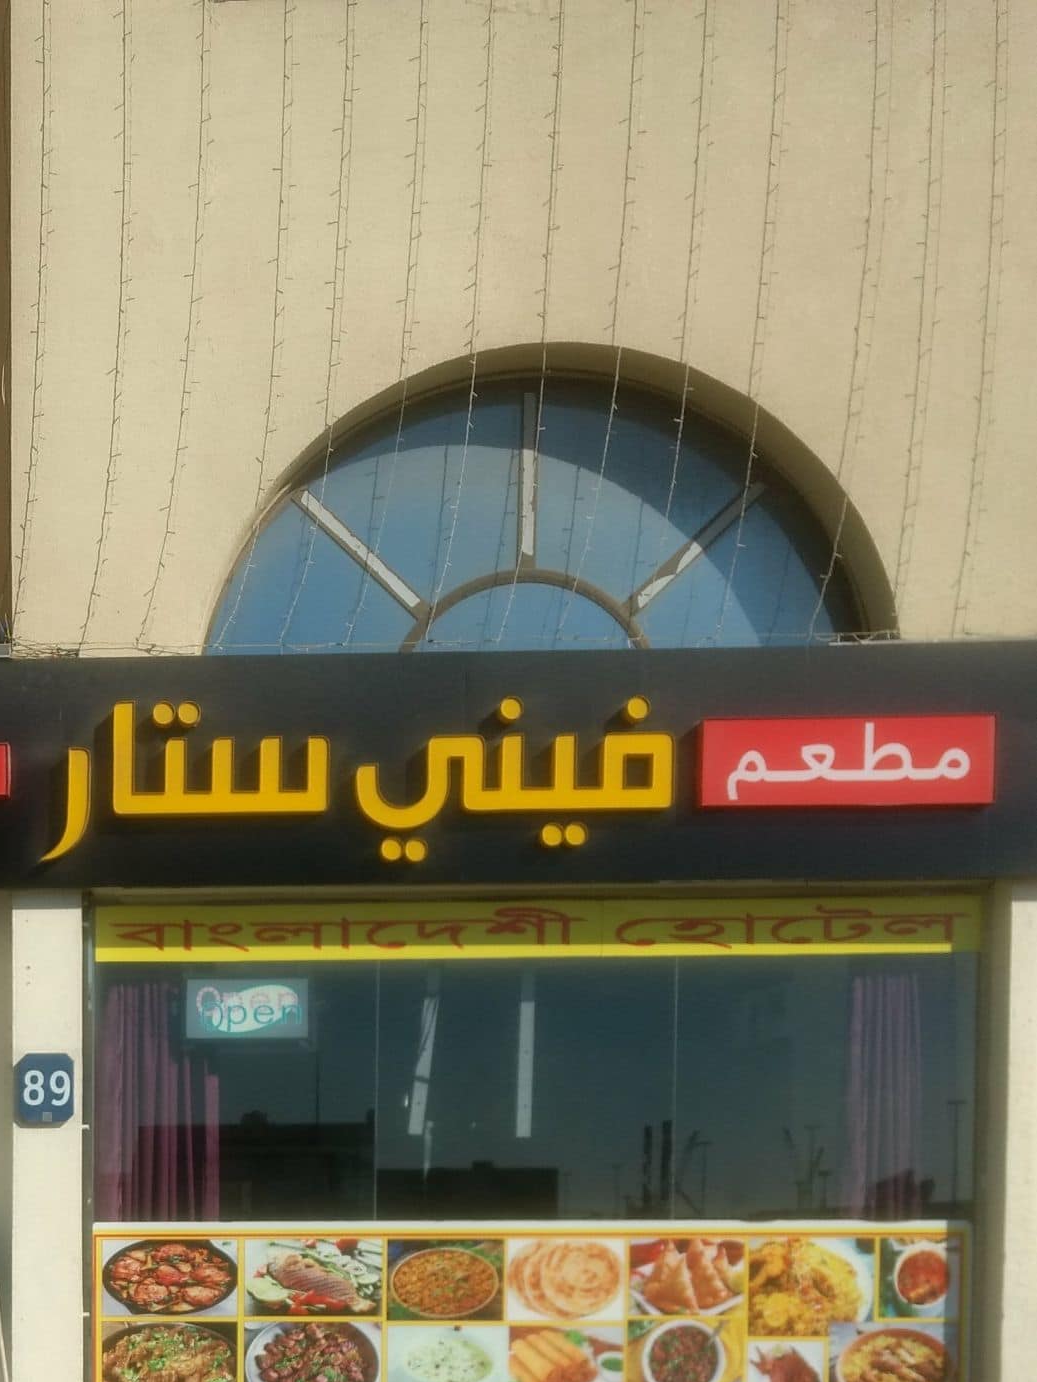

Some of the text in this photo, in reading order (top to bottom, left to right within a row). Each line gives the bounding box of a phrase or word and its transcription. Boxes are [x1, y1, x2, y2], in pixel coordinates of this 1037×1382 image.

[38, 695, 971, 862] مطعم فيني ستار
[110, 904, 972, 952] বাংলাদেশী হোটেল
[196, 986, 302, 1032] Open
[23, 1070, 71, 1106] 89
